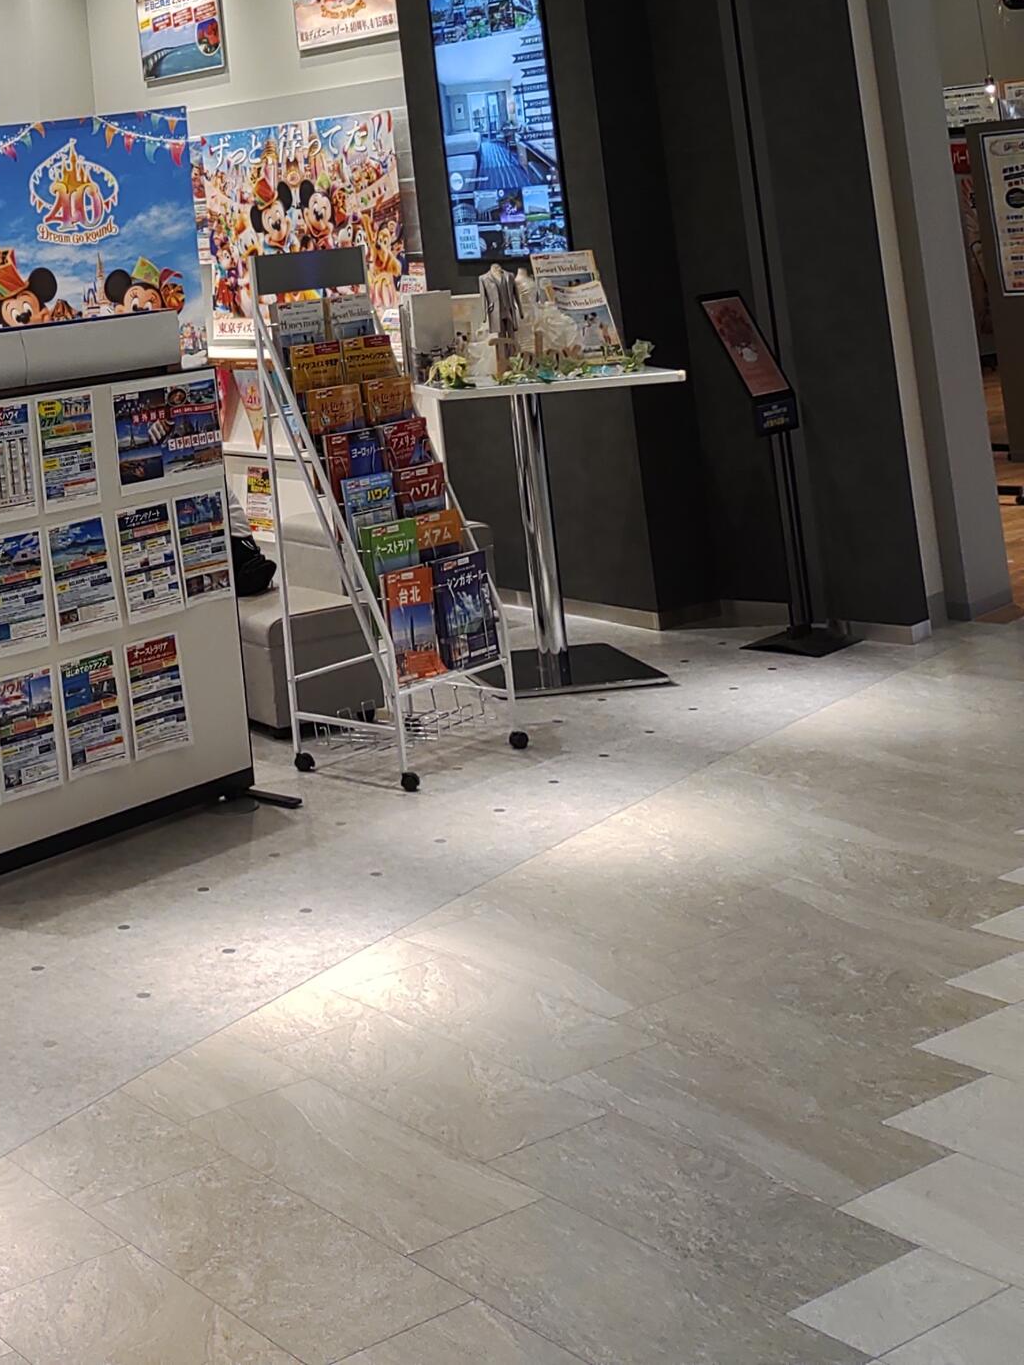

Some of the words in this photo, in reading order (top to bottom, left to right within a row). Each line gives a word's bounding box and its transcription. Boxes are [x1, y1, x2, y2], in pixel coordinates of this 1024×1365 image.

[44, 181, 104, 231] 40
[39, 225, 71, 242] Dream
[73, 233, 84, 243] Go
[86, 218, 115, 242] Round
[558, 262, 588, 273] Wedding
[575, 296, 604, 307] Wedding
[399, 585, 421, 604] 台北
